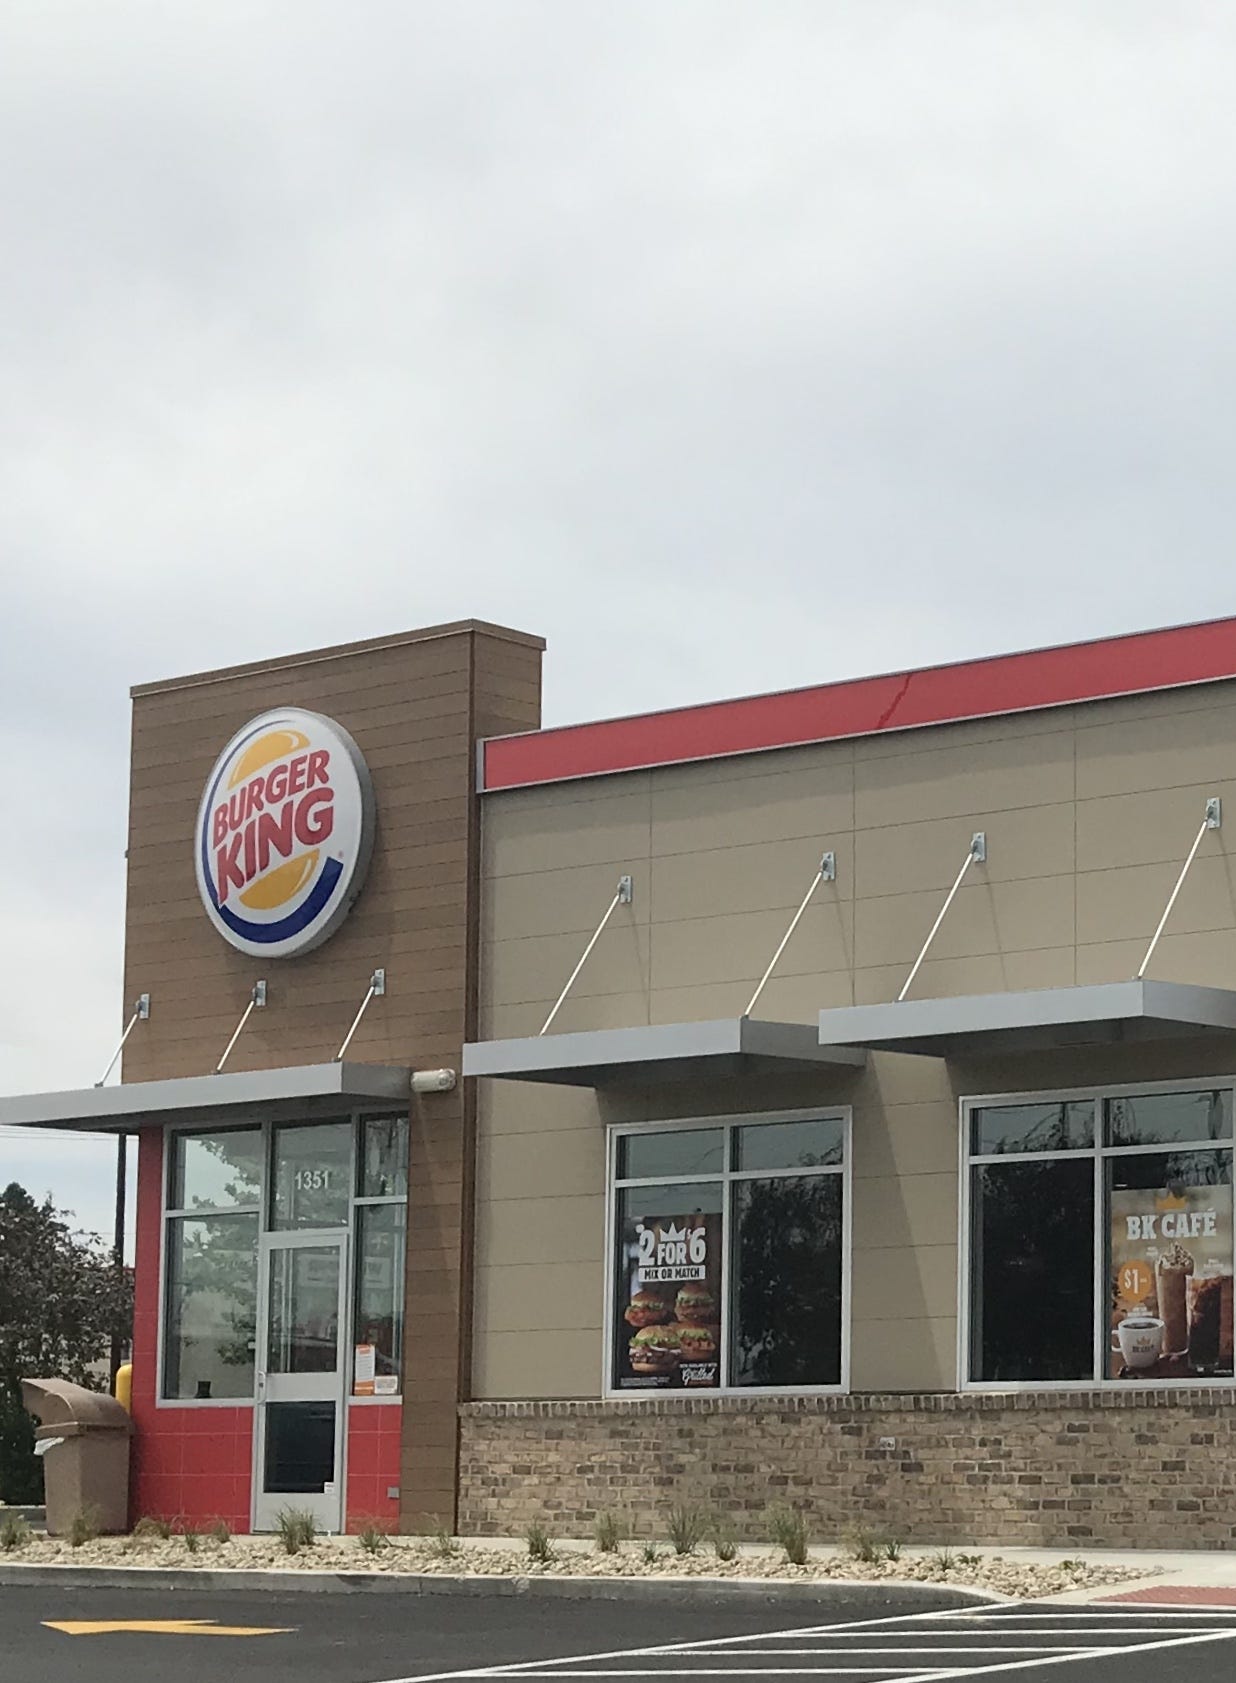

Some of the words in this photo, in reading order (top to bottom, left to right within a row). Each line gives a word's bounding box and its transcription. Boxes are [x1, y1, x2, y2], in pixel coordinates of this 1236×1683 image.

[213, 750, 330, 849] BURGER
[217, 787, 335, 904] KING
[295, 1170, 329, 1190] 1351
[1126, 1214, 1159, 1240] BK
[1161, 1208, 1217, 1238] CAFÉ
[636, 1224, 655, 1266] 2
[657, 1242, 687, 1265] FOR
[644, 1268, 659, 1280] MIX
[661, 1268, 673, 1279] OR
[675, 1267, 700, 1278] MATCH
